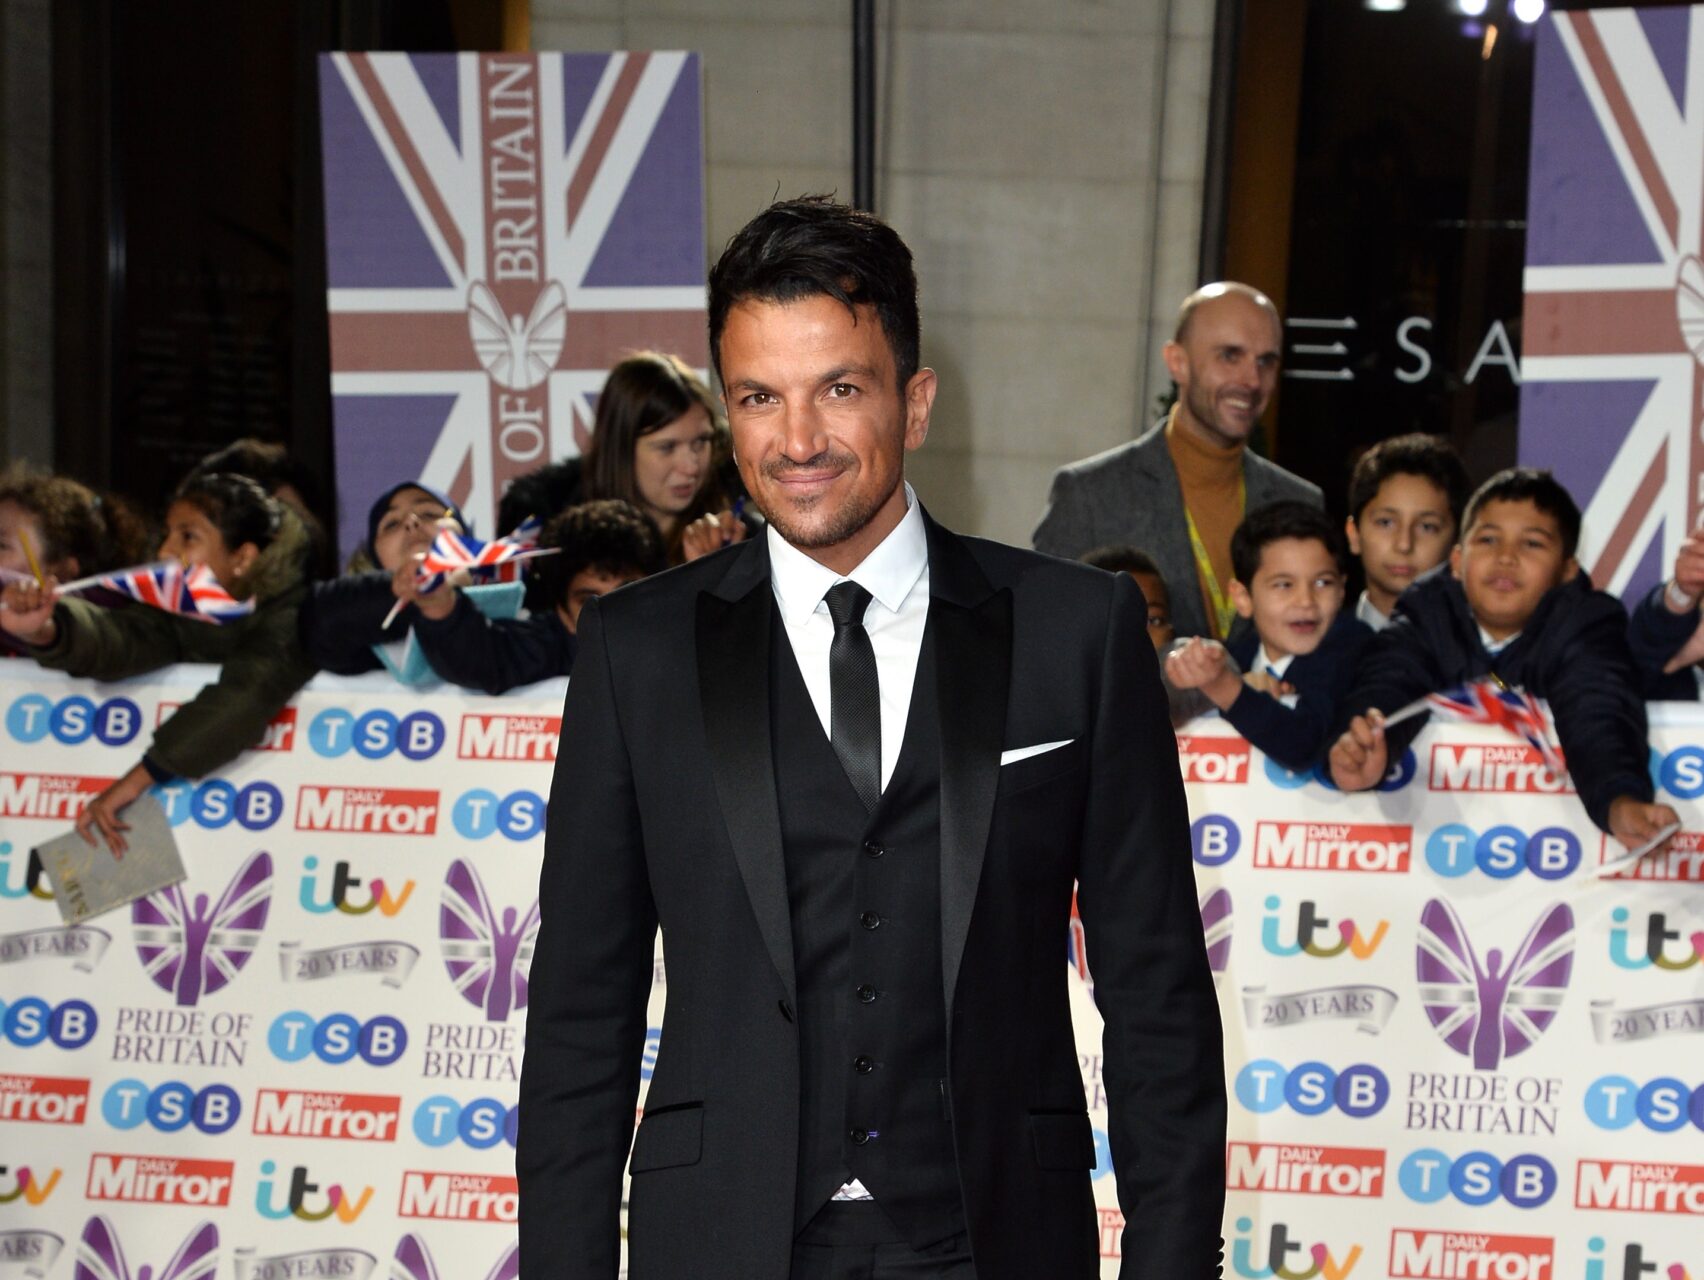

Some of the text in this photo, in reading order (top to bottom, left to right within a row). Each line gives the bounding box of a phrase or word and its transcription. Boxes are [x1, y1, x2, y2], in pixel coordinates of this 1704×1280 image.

[487, 59, 544, 463] OF BRITAIN
[20, 702, 132, 738] TSB
[322, 717, 435, 752] TSB
[508, 718, 548, 732] DAILY
[460, 716, 559, 760] Mirr
[1484, 748, 1528, 761] DAILY
[41, 777, 81, 792] DAILY
[345, 789, 385, 803] DAILY
[161, 787, 272, 822] TSB
[297, 788, 436, 834] Mirror
[1255, 823, 1409, 870] Mirror
[1307, 826, 1350, 839] DAILY
[1441, 834, 1569, 871] TSB
[298, 855, 416, 917] itv
[1261, 894, 1391, 961] itv
[297, 949, 399, 978] 20 YEARS
[13, 1005, 88, 1041] SB
[116, 1007, 254, 1039] PRIDE OF
[1262, 993, 1375, 1024] 20 YEARS
[283, 1021, 397, 1058] TSB
[425, 1023, 516, 1051] PRIDE
[1611, 1016, 1639, 1038] 20
[111, 1035, 248, 1068] BRITAIN
[421, 1051, 519, 1083] BRITA
[305, 1094, 345, 1109] DAILY
[1250, 1069, 1378, 1109] TSB
[1407, 1072, 1564, 1105] PRIDE OF
[116, 1088, 230, 1126] TSB
[255, 1091, 396, 1139] Mirror
[1404, 1100, 1560, 1136] BRITAIN
[138, 1159, 178, 1174] DAILY
[1228, 1143, 1383, 1195] Mirror
[1280, 1147, 1324, 1163] DAILY
[1632, 1164, 1678, 1181] DAILY
[88, 1156, 230, 1205] Mirror
[255, 1159, 375, 1224] itv
[451, 1176, 492, 1191] DAILY
[1415, 1159, 1545, 1199] TSB
[1577, 1161, 1704, 1214] Mirro
[401, 1173, 518, 1222] Mirro
[1445, 1235, 1490, 1251] DAILY
[281, 1256, 355, 1279] YEARS
